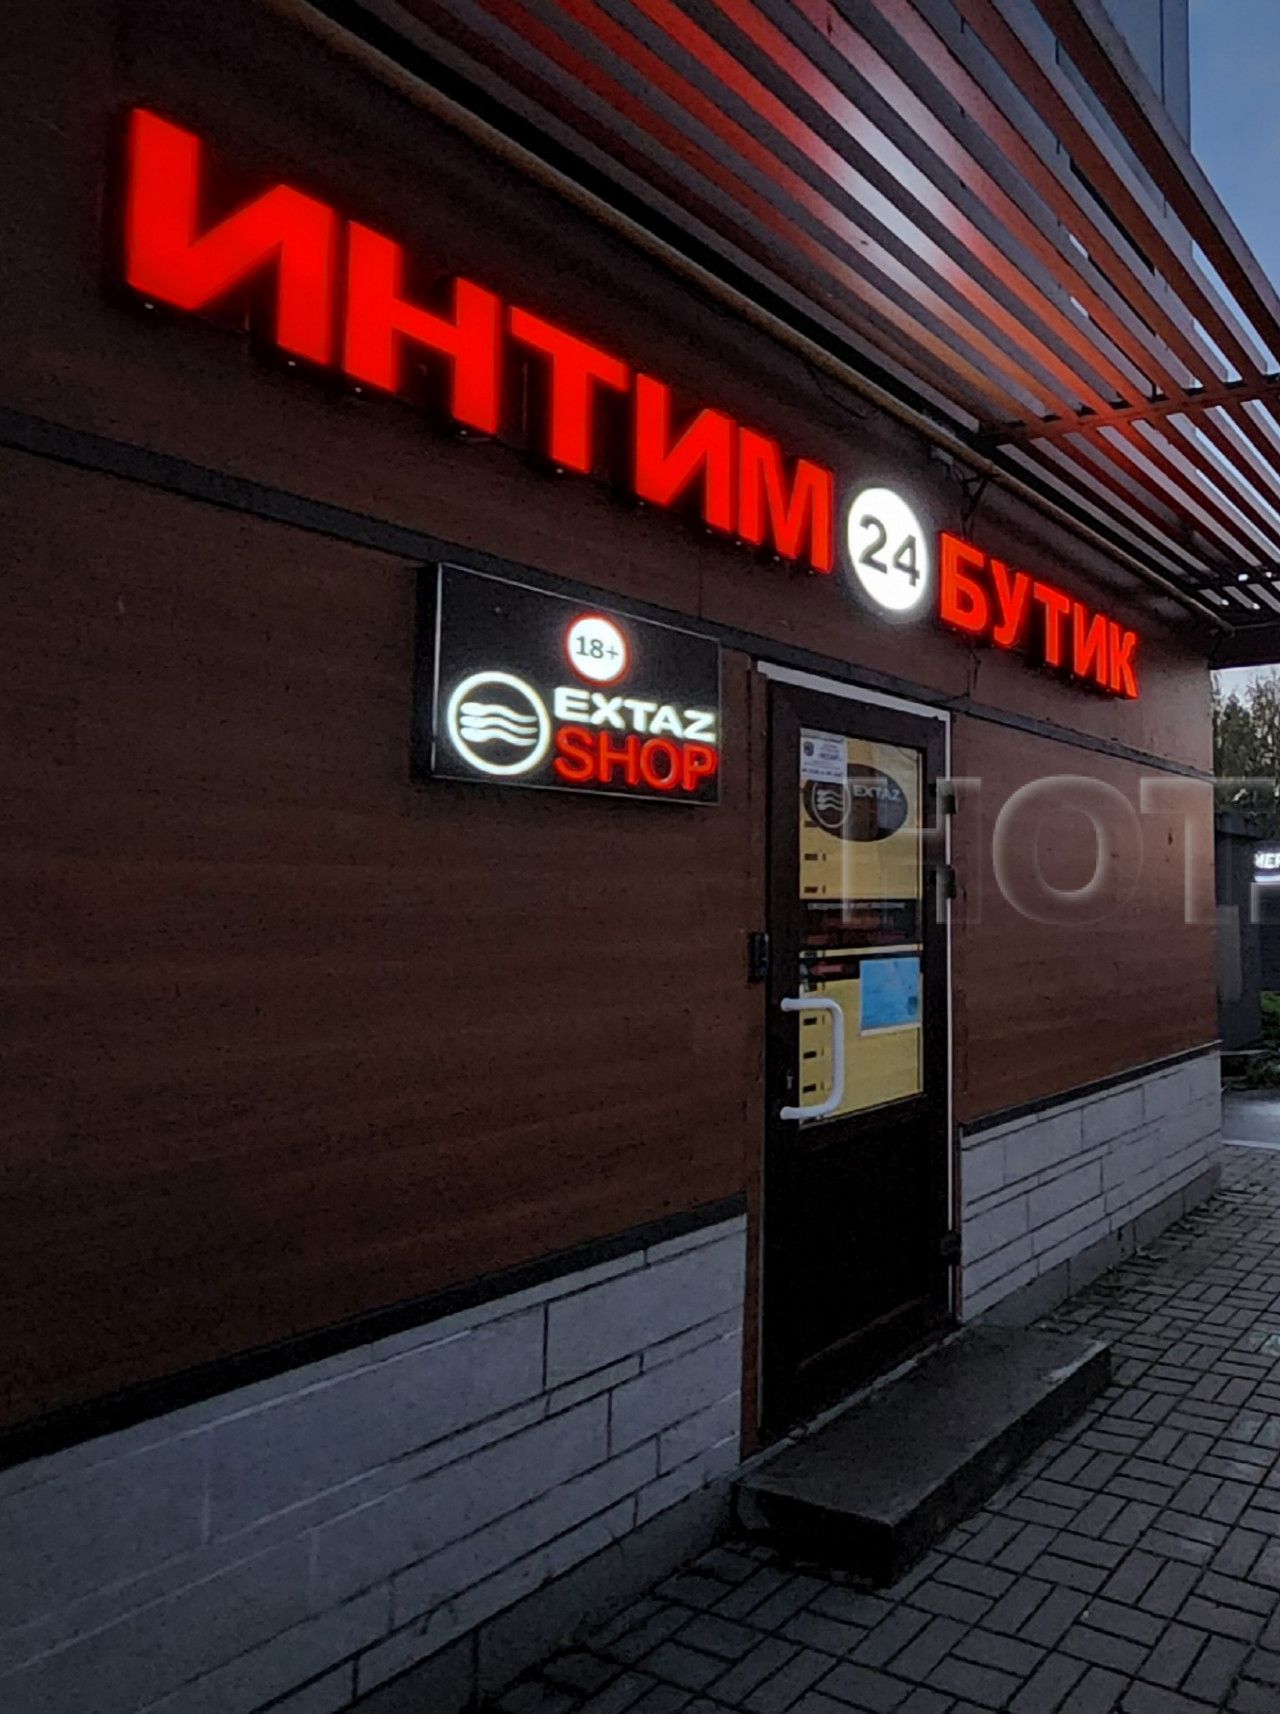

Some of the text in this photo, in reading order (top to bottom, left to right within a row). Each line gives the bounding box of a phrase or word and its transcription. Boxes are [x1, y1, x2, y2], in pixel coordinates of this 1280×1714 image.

[126, 107, 834, 573] ИНТИМ
[858, 514, 920, 587] 24
[575, 635, 619, 660] 18+
[939, 531, 1139, 700] БУТИК
[554, 686, 717, 743] EXTAZ
[553, 724, 719, 792] SHOP
